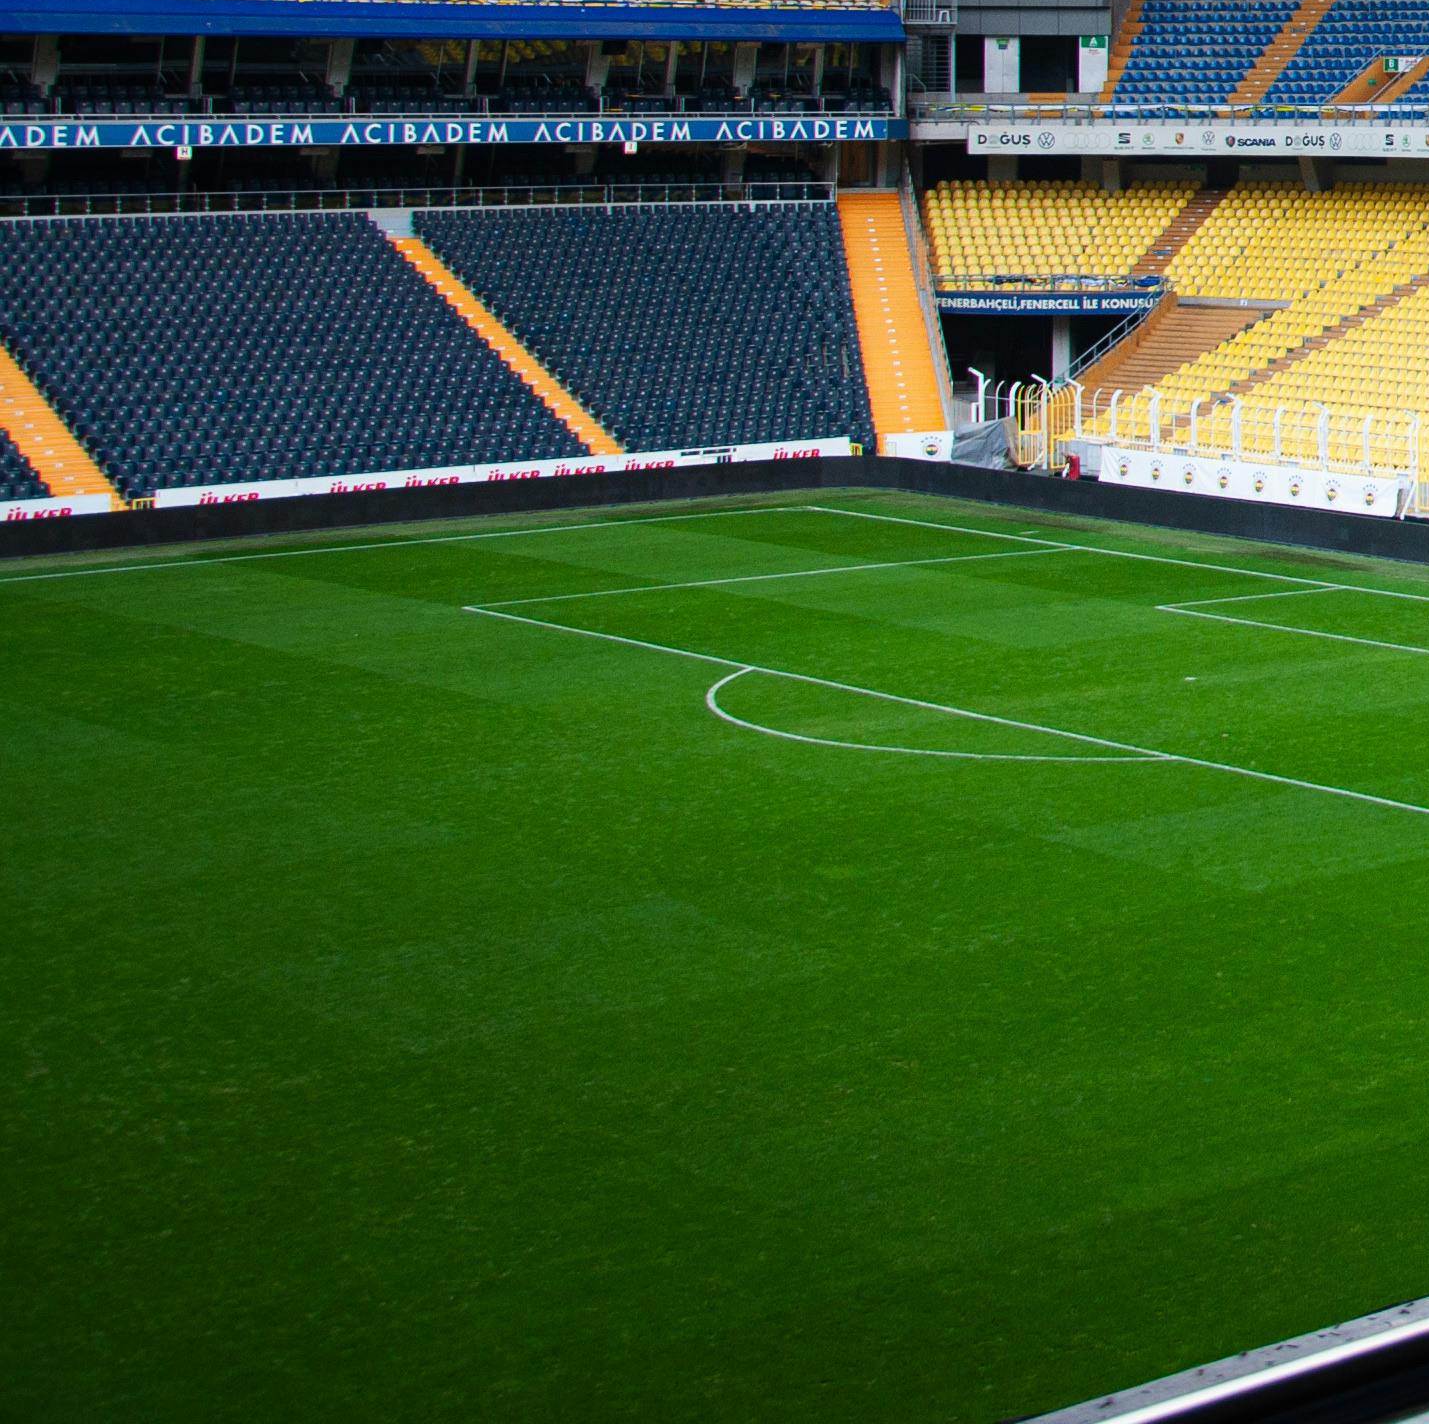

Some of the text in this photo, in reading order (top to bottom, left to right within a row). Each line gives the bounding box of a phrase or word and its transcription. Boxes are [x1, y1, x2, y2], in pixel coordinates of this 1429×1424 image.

[130, 123, 314, 146] ACIBADEM
[340, 122, 508, 144] ACIBADEM
[533, 121, 691, 142] ACIBADEM
[716, 120, 875, 140] ACIBADEM
[1237, 139, 1276, 147] SCANIA
[1083, 296, 1098, 309] İLE
